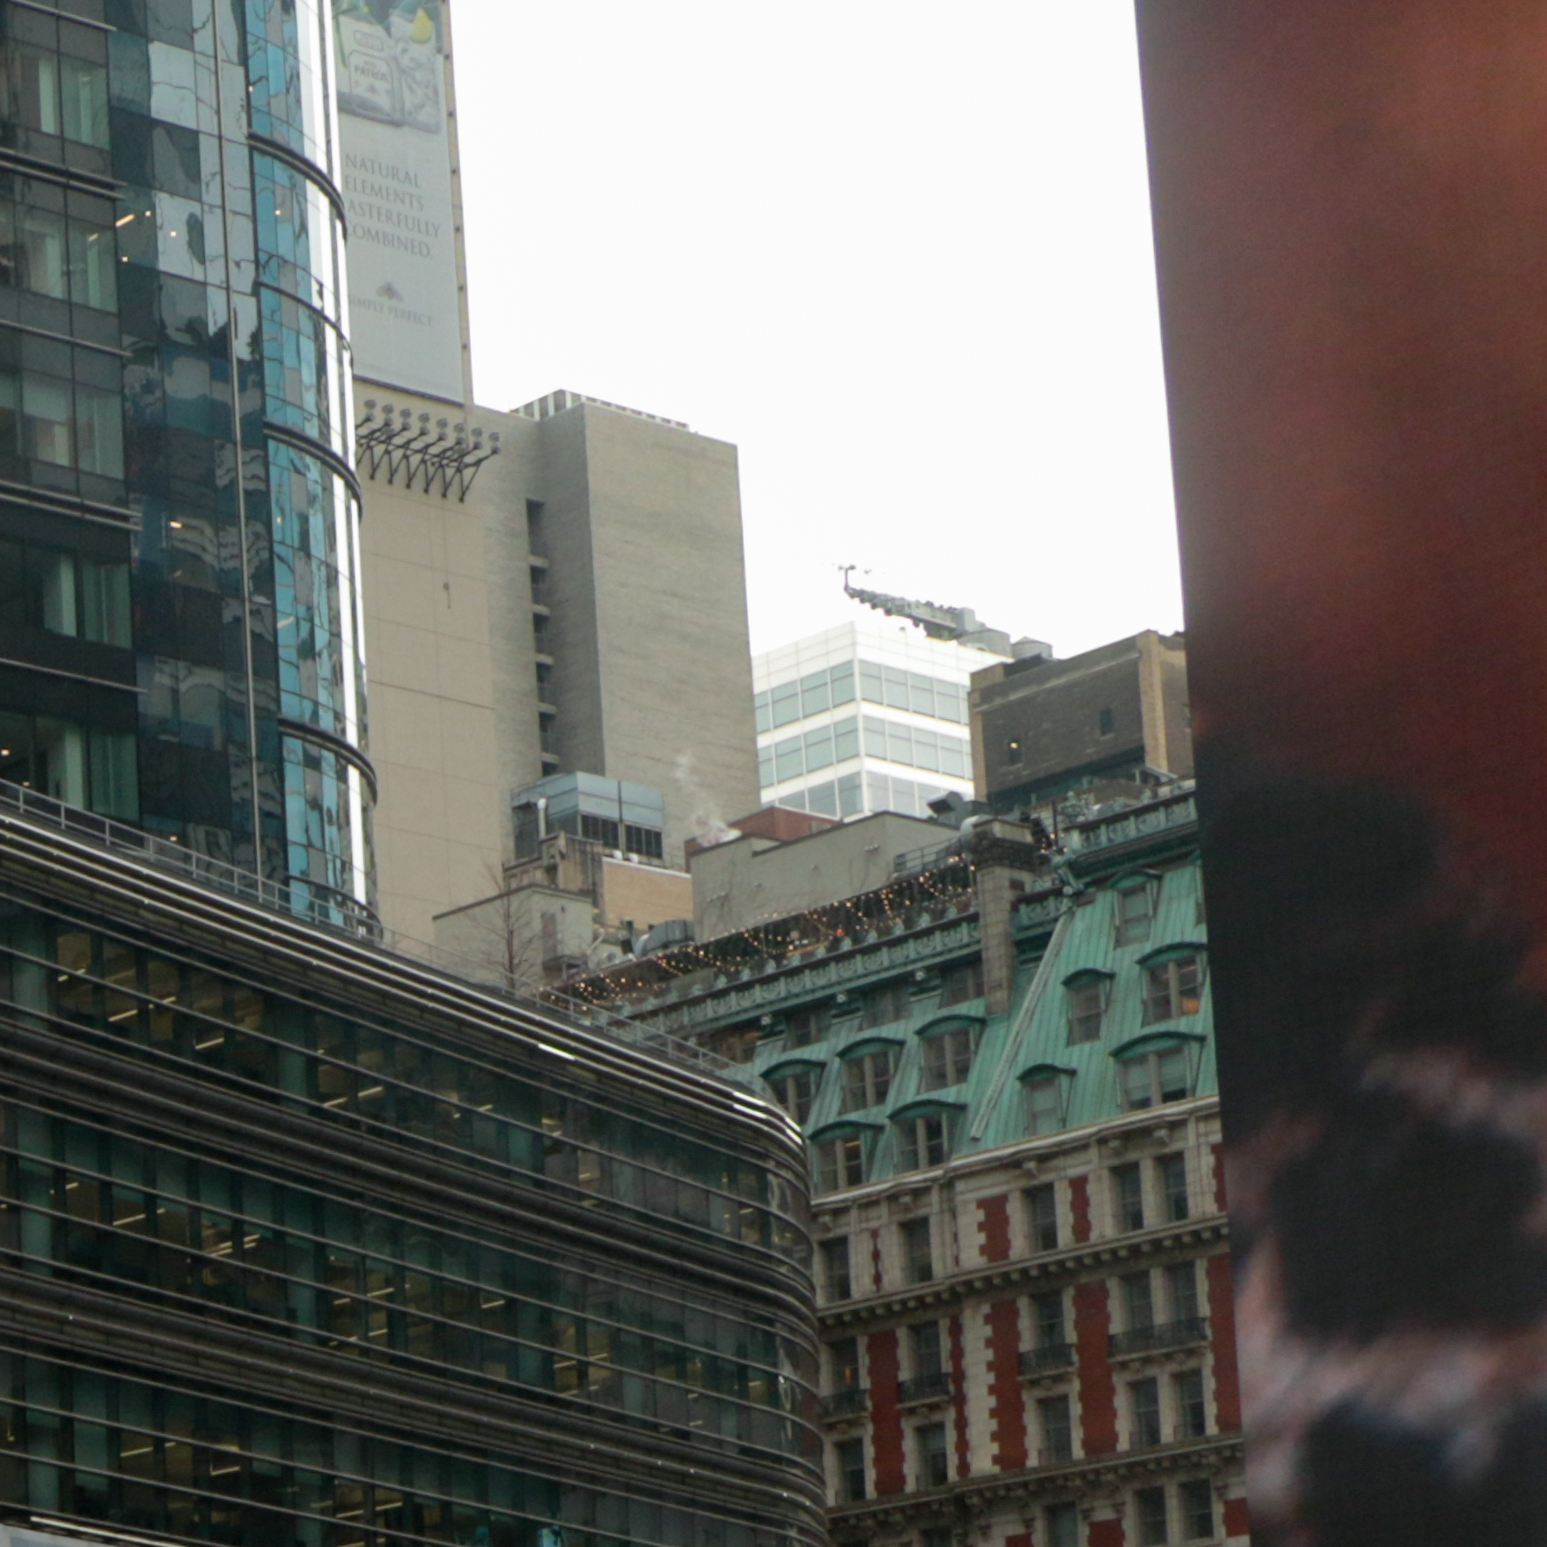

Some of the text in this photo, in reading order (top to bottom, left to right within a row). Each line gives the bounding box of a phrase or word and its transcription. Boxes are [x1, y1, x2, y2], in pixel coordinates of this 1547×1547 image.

[344, 152, 422, 189] NATURAL
[343, 174, 425, 212] ELEMENTS
[347, 199, 442, 239] ASTERFULLY
